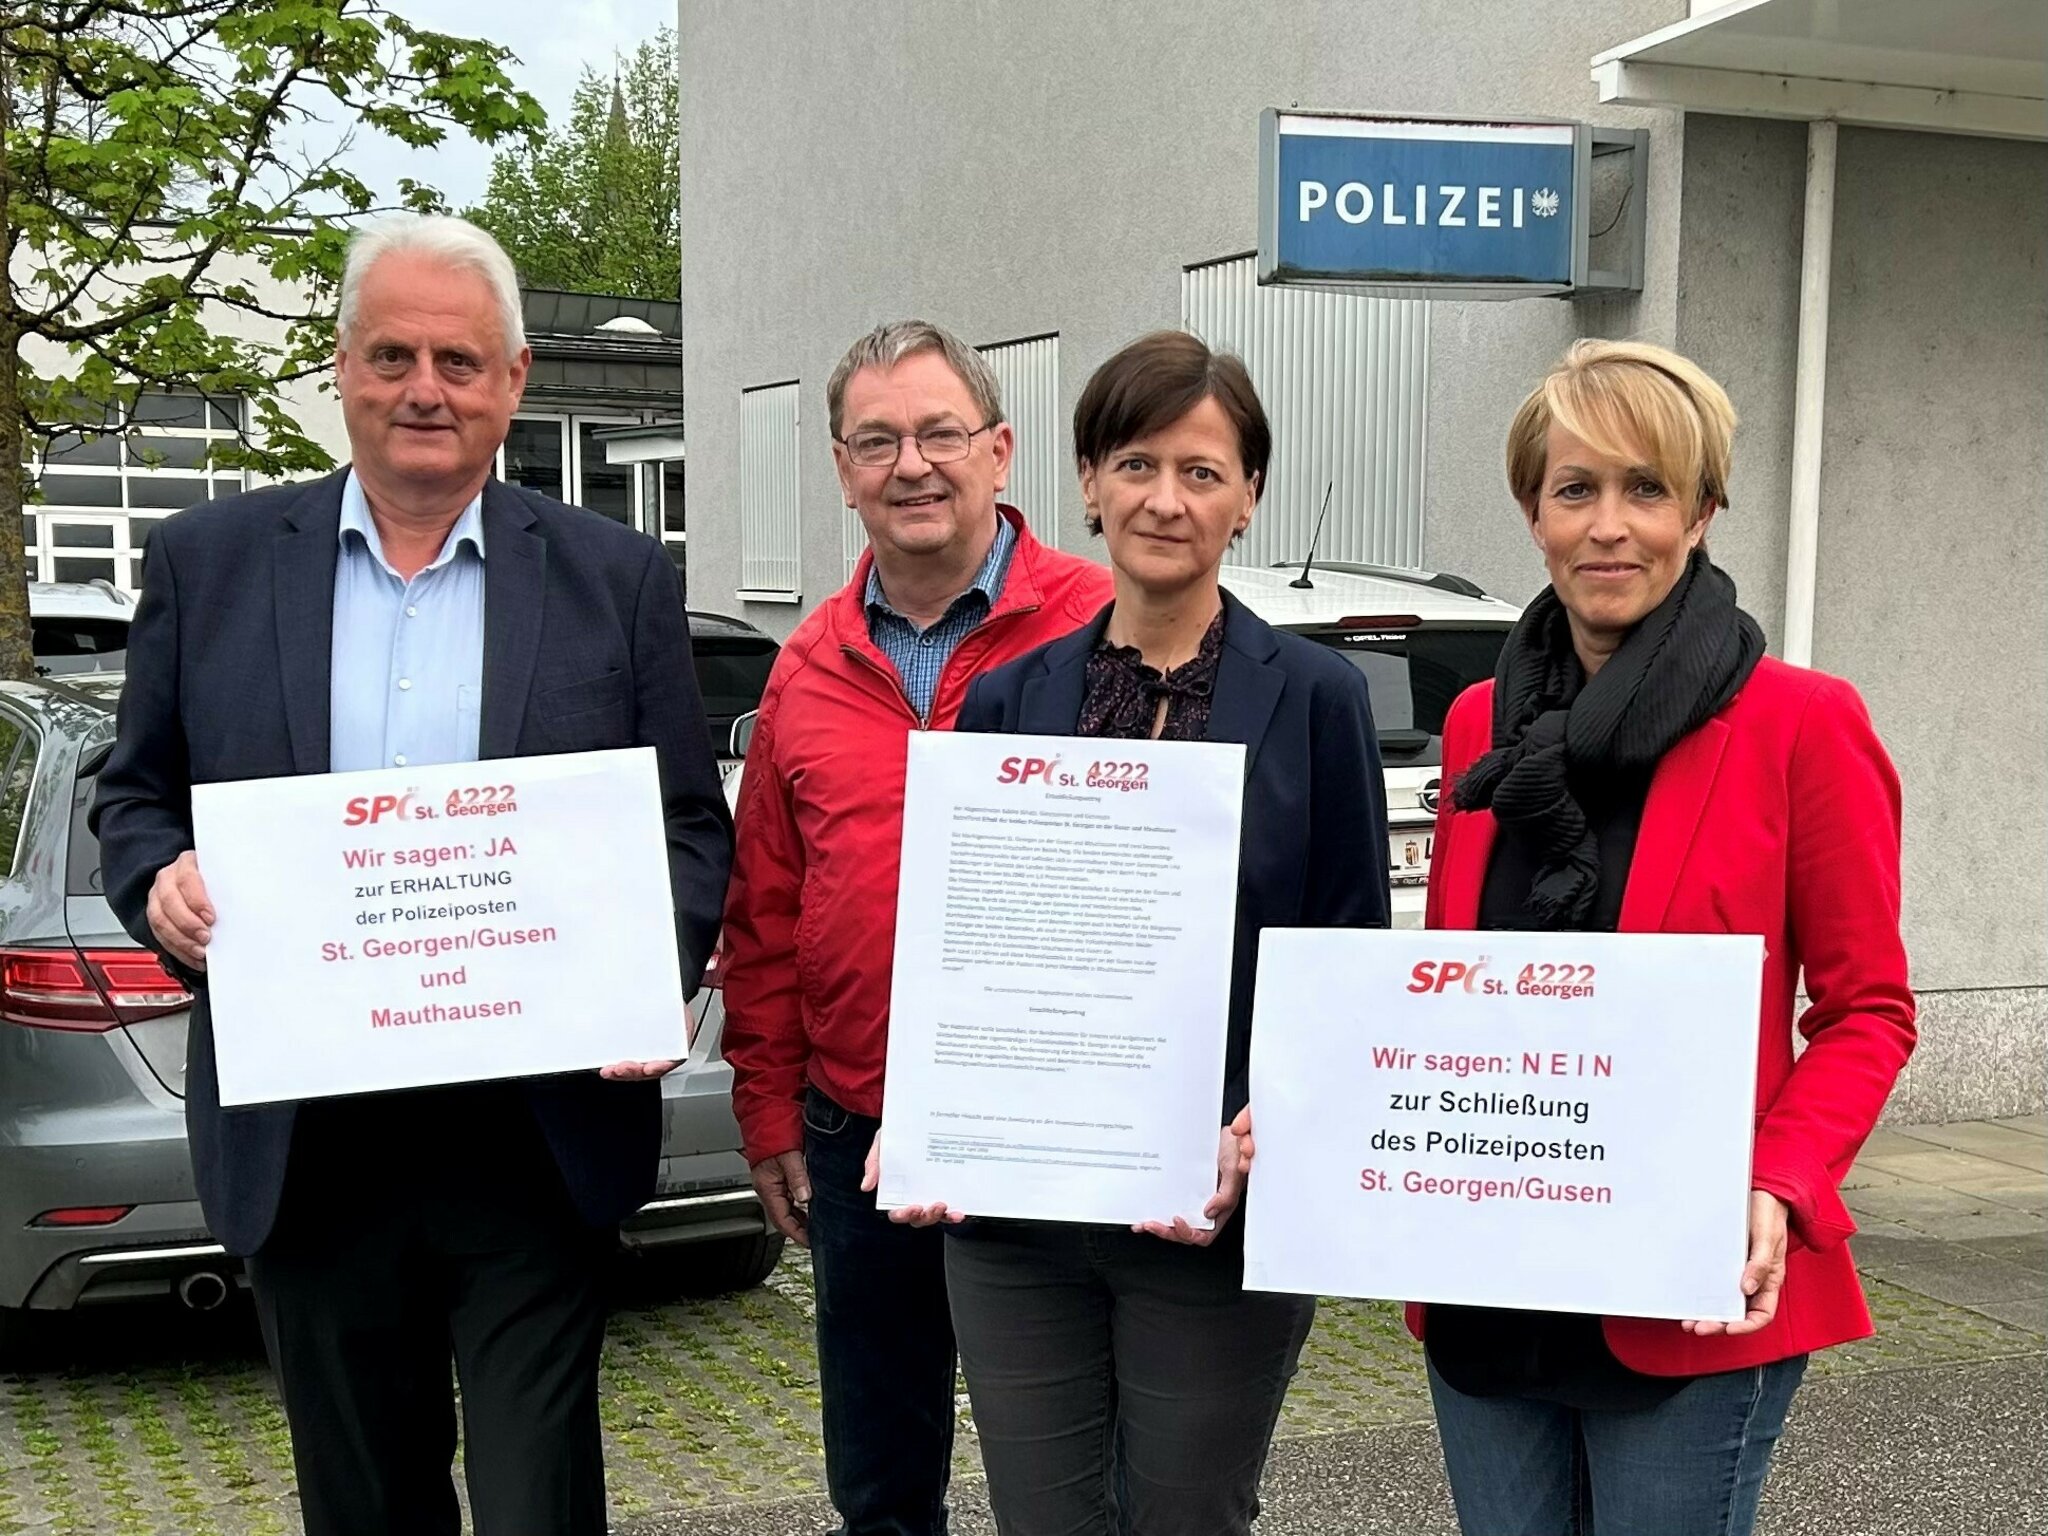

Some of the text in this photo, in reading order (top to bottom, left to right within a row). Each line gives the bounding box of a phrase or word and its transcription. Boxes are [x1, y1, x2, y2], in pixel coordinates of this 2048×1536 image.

[1300, 182, 1522, 227] POLIZEI
[1059, 773, 1079, 787] St.
[1086, 775, 1148, 792] Georgen
[1088, 761, 1149, 779] 4222
[446, 786, 516, 805] 4222
[415, 806, 439, 820] St.
[445, 800, 517, 817] Georgen
[342, 837, 517, 869] Wir sagen: JA
[355, 870, 512, 898] zur ERHALTUNG
[355, 898, 517, 925] der Polizeiposten
[322, 926, 556, 962] St. Georgen/Gusen
[420, 966, 466, 988] und
[1518, 963, 1595, 983] 4222
[1483, 979, 1508, 995] St.
[1516, 980, 1594, 1000] Georgen
[371, 1001, 521, 1028] Mauthausen
[1372, 1047, 1417, 1070] Wir
[1424, 1054, 1511, 1078] sagen:
[1389, 1090, 1589, 1124] zur Schließung
[1371, 1129, 1605, 1163] des Polizeiposten
[1360, 1168, 1611, 1203] St. Georgen/Gusen
